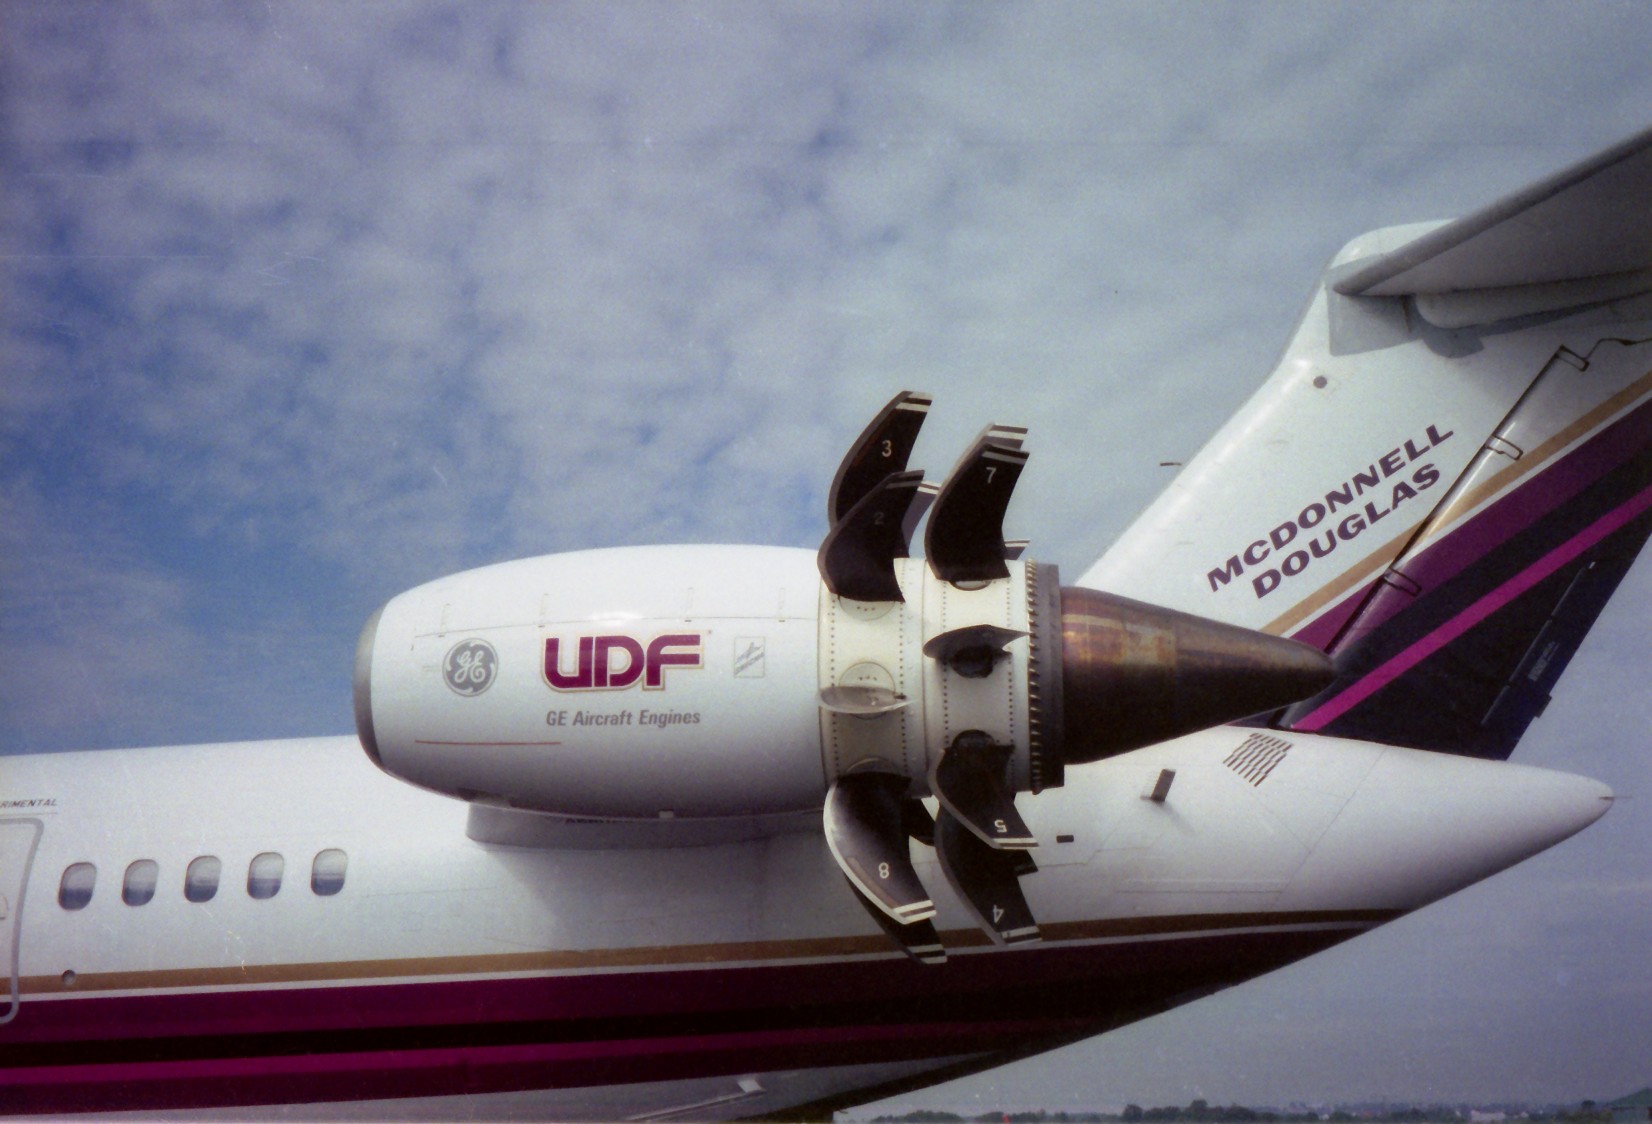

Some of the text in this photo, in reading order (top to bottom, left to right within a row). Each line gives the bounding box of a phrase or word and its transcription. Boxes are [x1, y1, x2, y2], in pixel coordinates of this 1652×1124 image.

[882, 440, 892, 457] 3
[985, 466, 997, 484] 7
[1207, 424, 1454, 592] MCDONNELL
[873, 512, 885, 525] 2
[1252, 463, 1440, 599] DOUGLAS
[454, 650, 486, 683] GE
[543, 633, 702, 690] UDF
[546, 709, 701, 728] GE Aircraft Engines
[994, 819, 1007, 833] 5
[878, 863, 890, 879] 8
[992, 905, 1004, 923] 4
